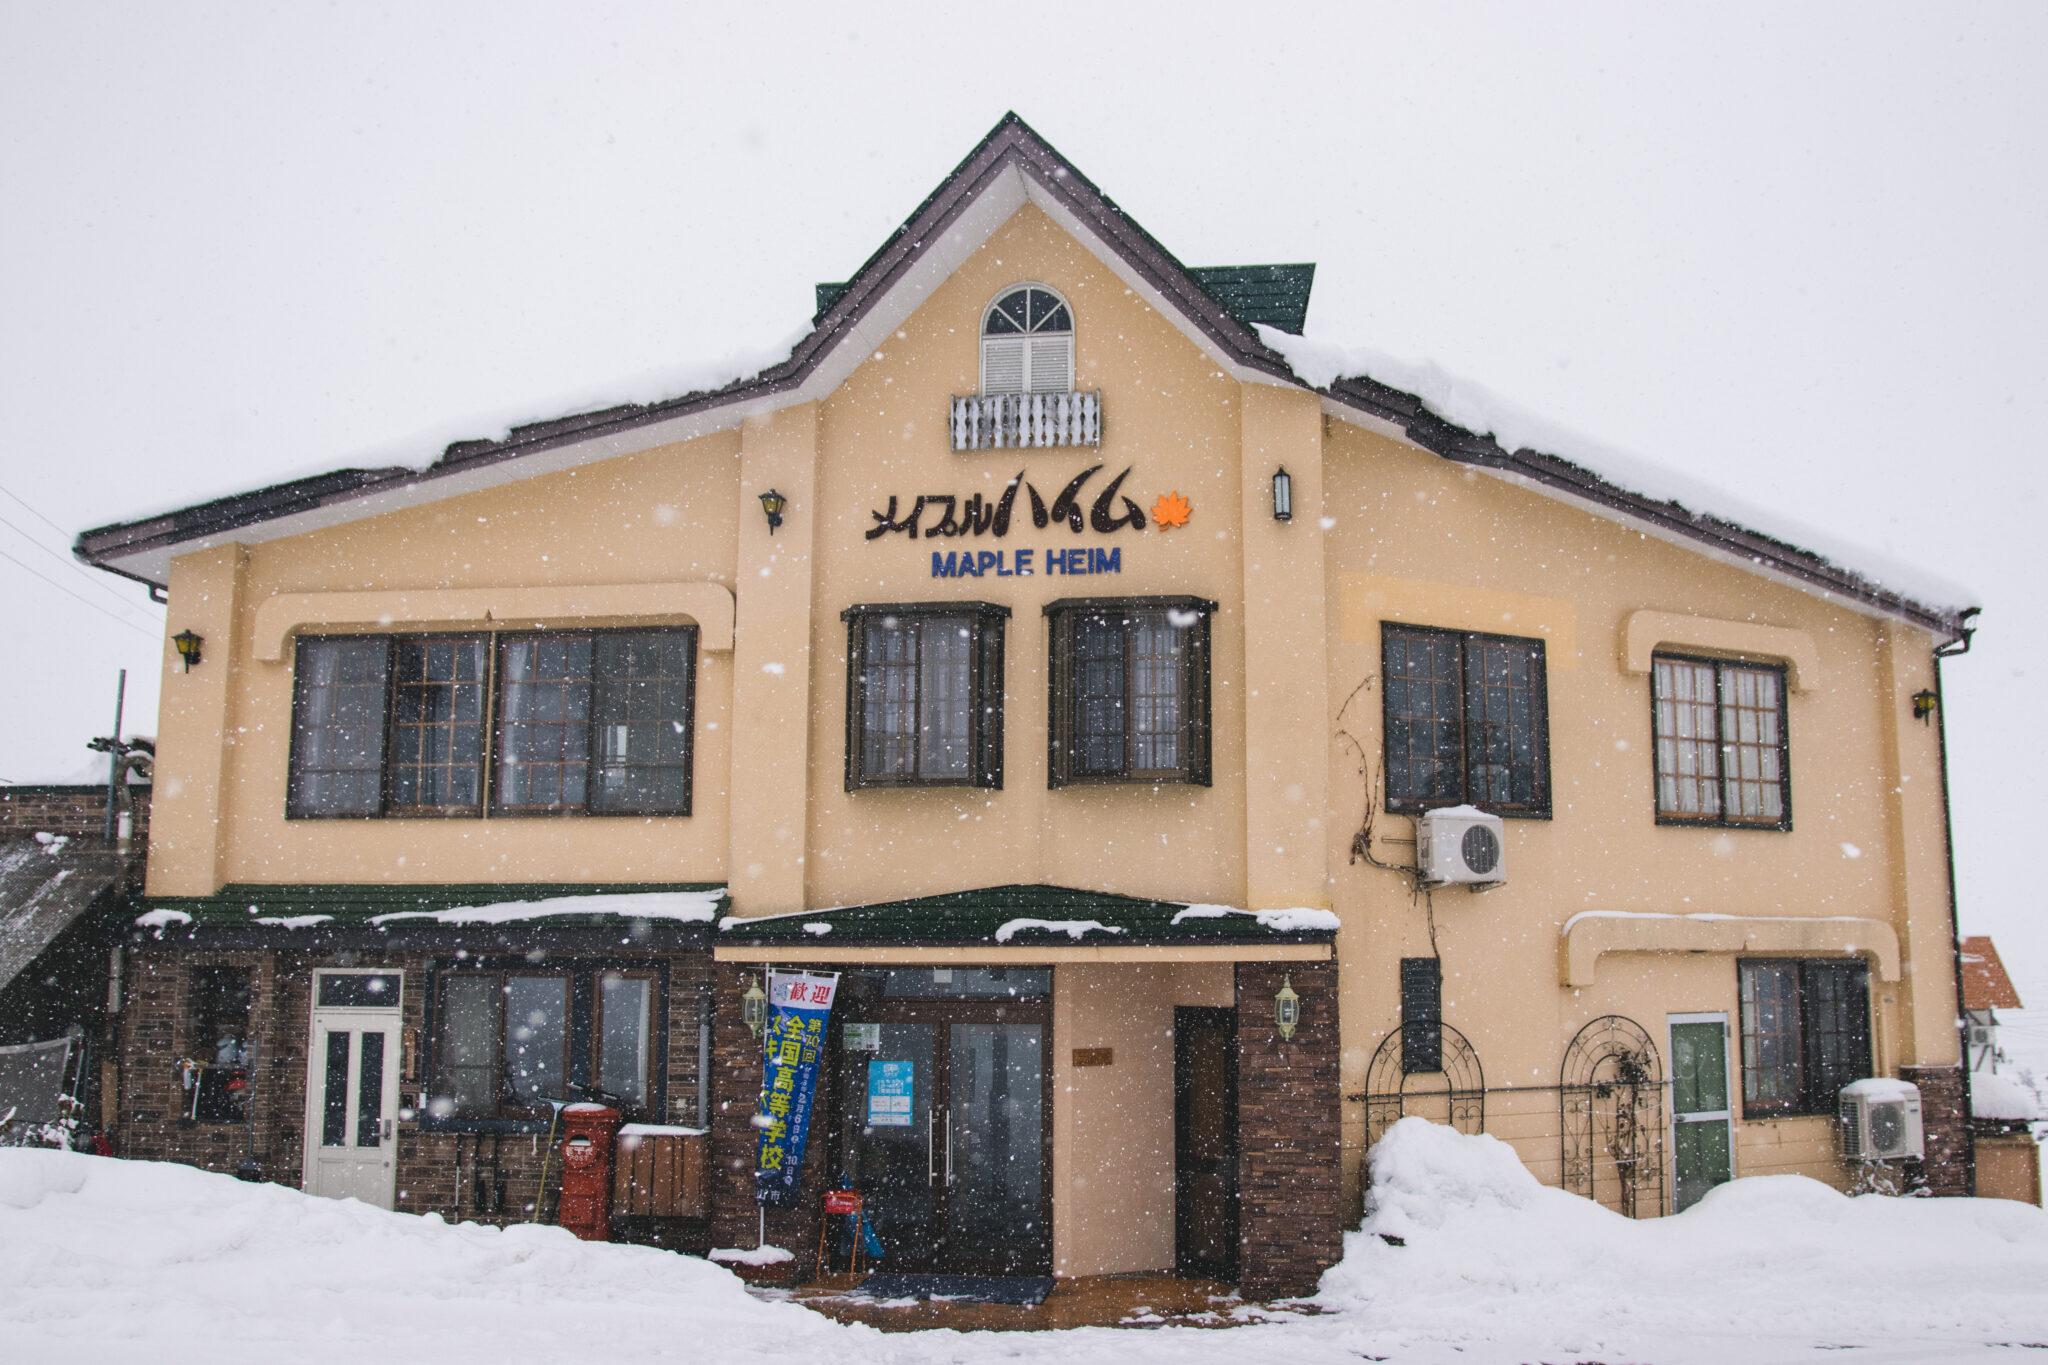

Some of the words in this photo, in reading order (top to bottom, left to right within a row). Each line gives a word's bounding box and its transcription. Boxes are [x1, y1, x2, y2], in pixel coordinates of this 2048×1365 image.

[865, 464, 1147, 540] メイプルハイム
[931, 549, 1034, 578] MAPLE
[1046, 547, 1121, 575] HEIM
[789, 982, 831, 1005] 歓迎
[801, 1018, 823, 1064] 第70回
[760, 1015, 806, 1170] 全国高等学校
